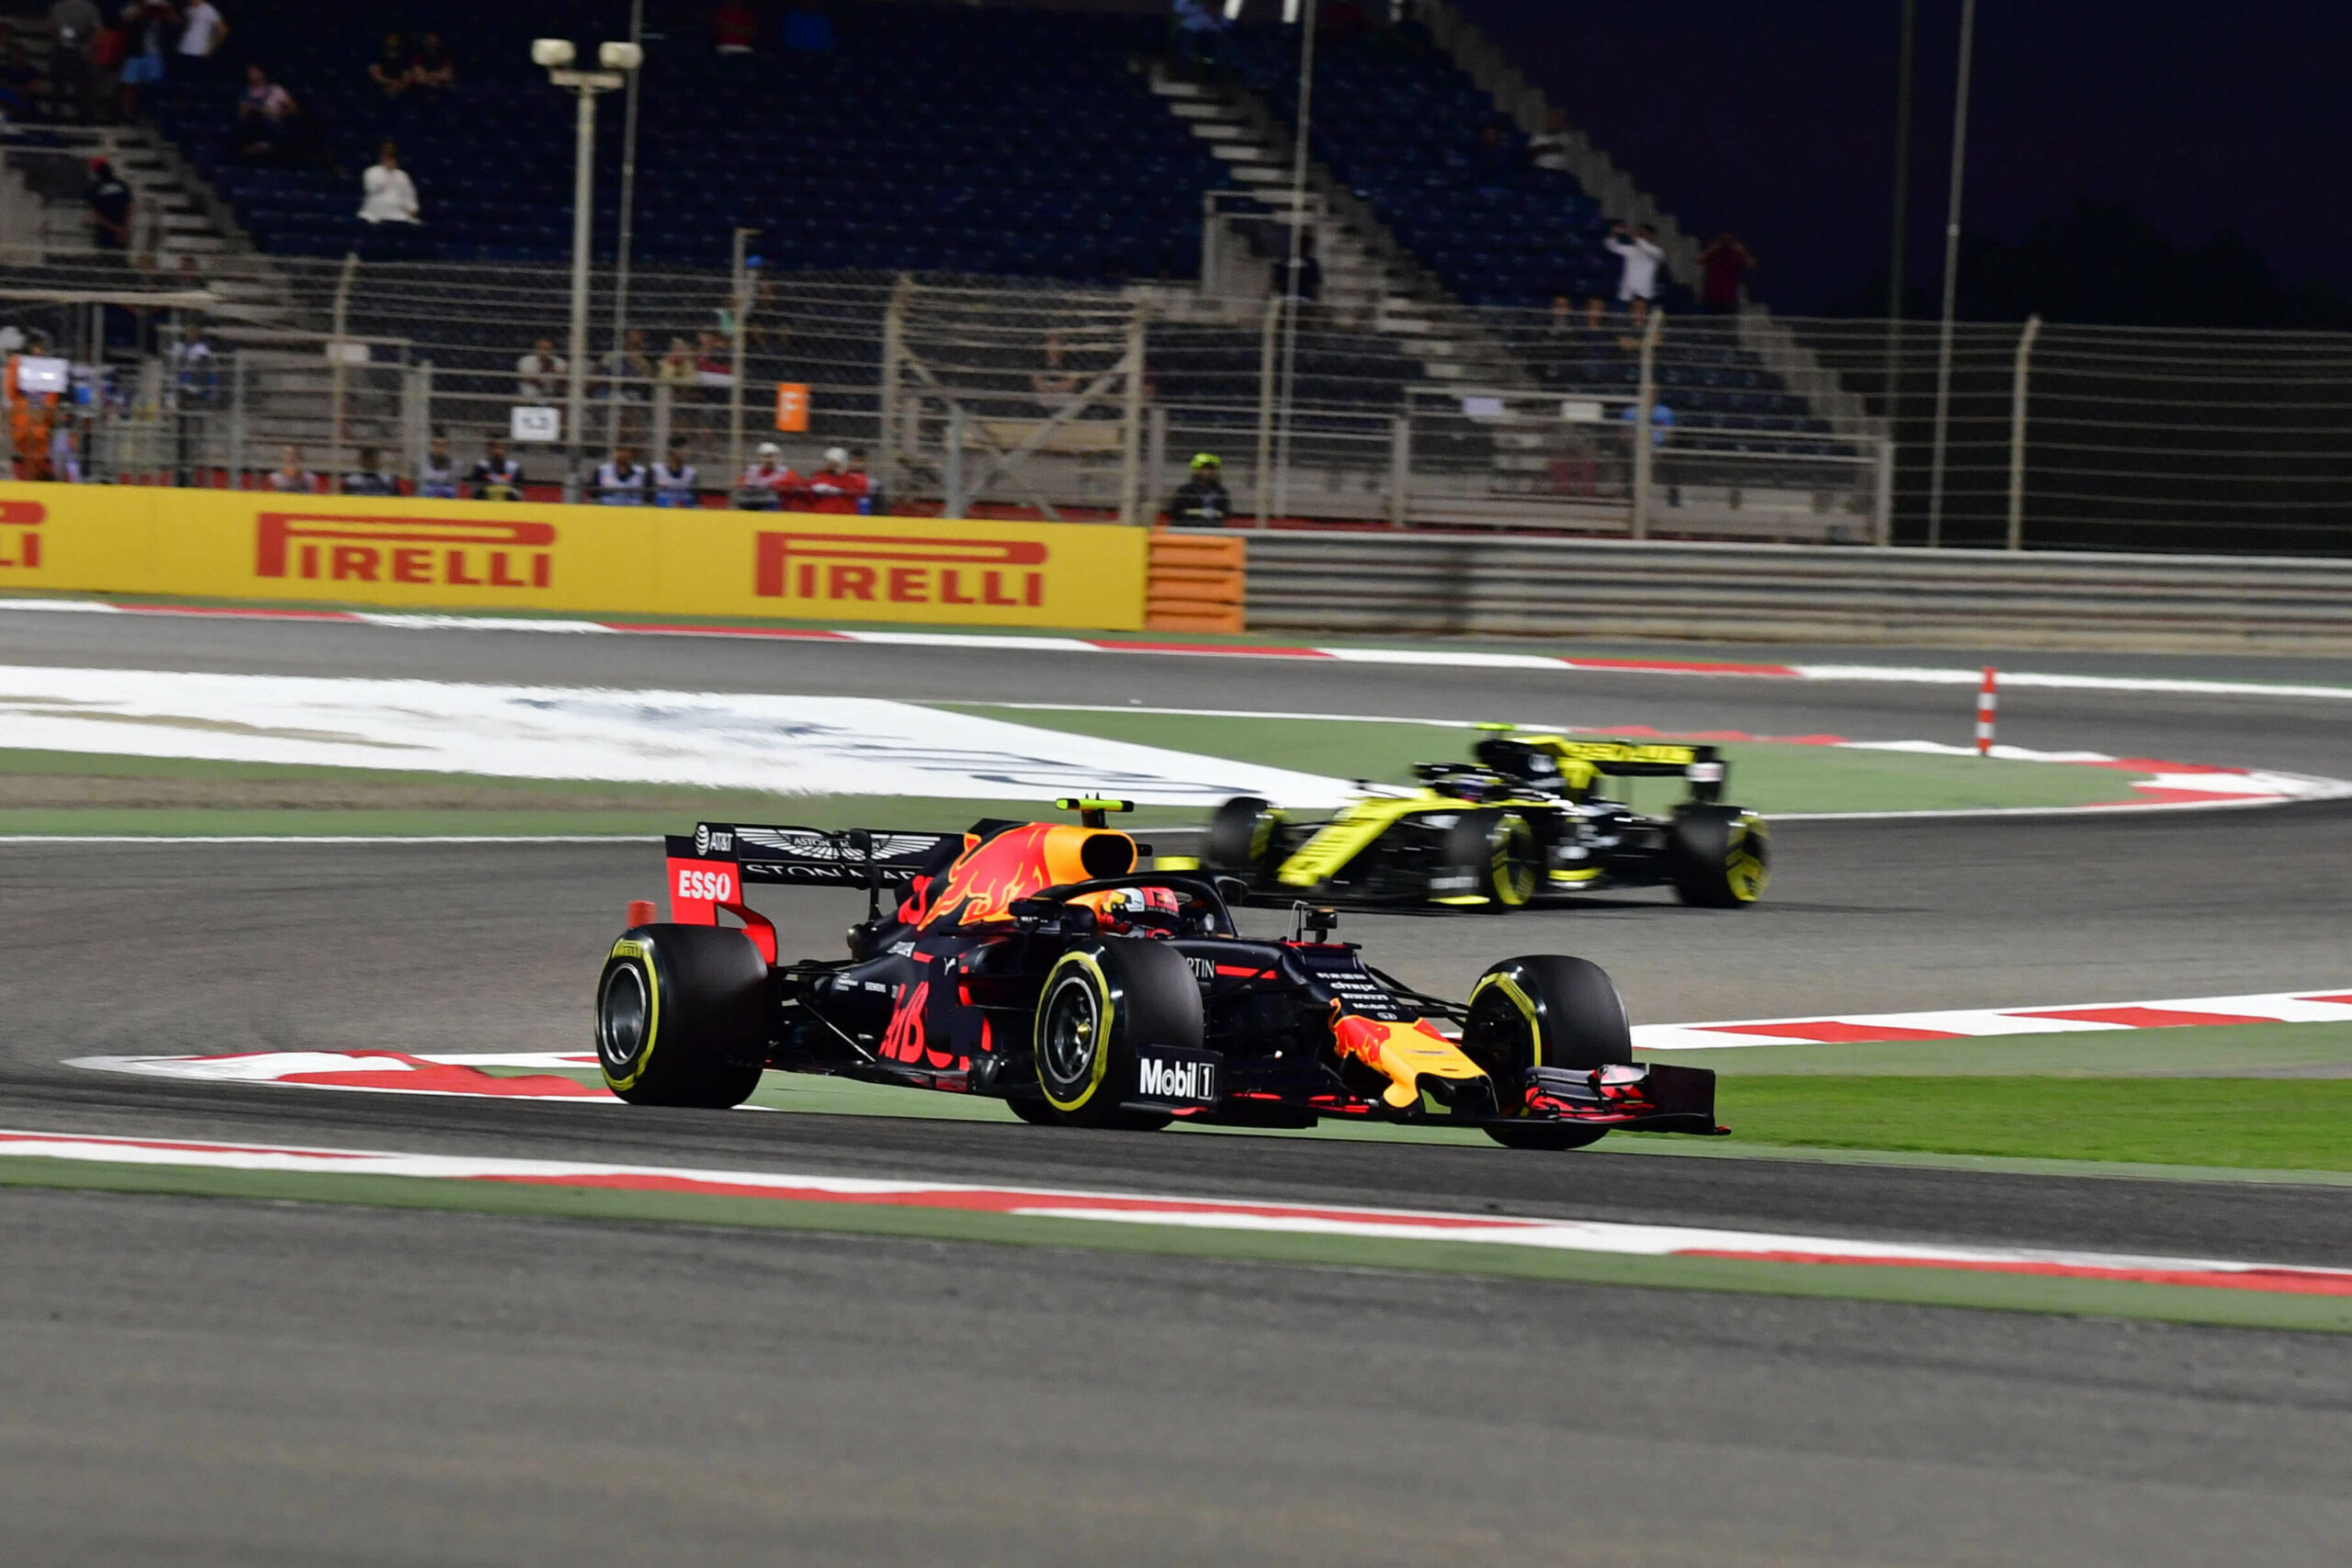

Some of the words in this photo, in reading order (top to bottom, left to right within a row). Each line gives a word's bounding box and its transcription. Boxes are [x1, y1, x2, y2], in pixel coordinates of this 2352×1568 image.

[255, 512, 558, 589] PIRELLI
[754, 530, 1049, 607] PIRELLI
[709, 831, 733, 852] AT&T
[794, 838, 831, 848] ASTON
[678, 869, 731, 902] ESSO
[1186, 957, 1215, 979] RTIN
[1139, 1058, 1197, 1099] Mobil
